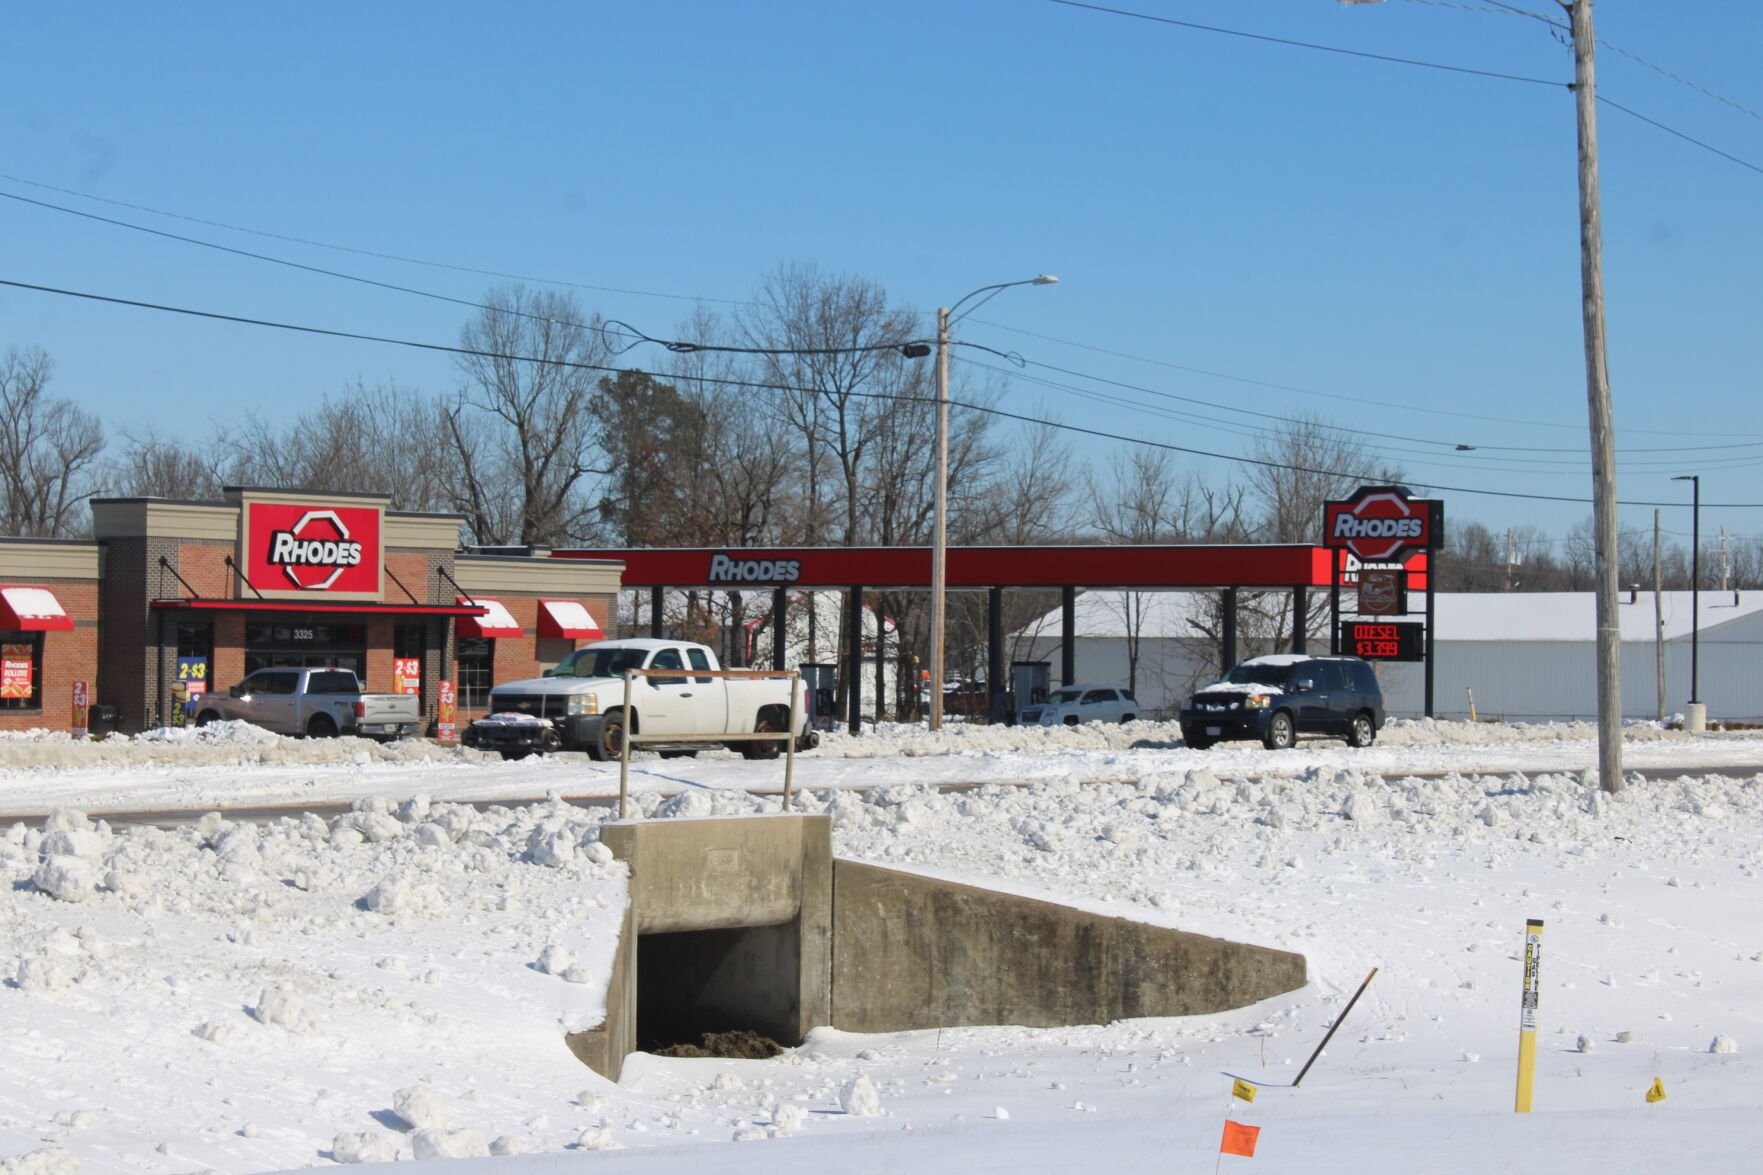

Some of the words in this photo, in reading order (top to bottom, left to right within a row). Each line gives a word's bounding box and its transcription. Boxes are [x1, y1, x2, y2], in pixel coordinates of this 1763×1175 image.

[1334, 513, 1422, 537] RHODES
[272, 532, 362, 565] RHODES
[709, 554, 800, 581] RHODES
[294, 629, 313, 640] 3325
[1354, 625, 1400, 640] DIESEL
